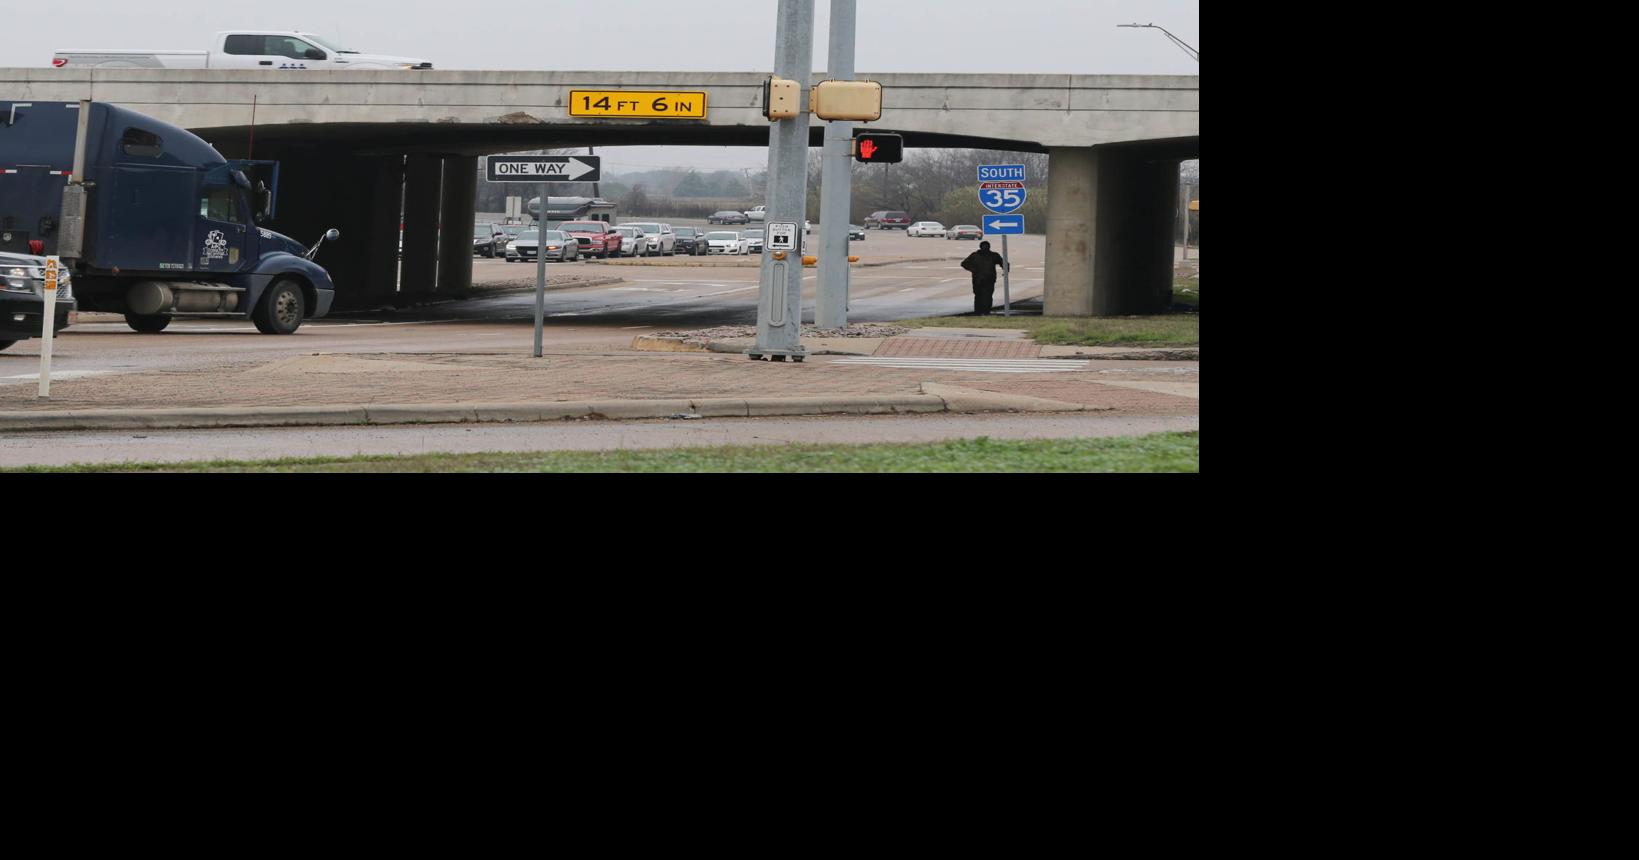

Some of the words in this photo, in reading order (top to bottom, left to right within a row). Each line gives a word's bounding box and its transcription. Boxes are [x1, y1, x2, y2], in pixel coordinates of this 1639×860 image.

[583, 96, 611, 111] 14
[617, 101, 640, 111] FT
[652, 97, 668, 112] 6
[675, 102, 692, 112] IN
[498, 163, 529, 174] ONE
[534, 163, 566, 174] WAY
[981, 167, 1023, 178] SOUTH
[986, 189, 1021, 208] 35
